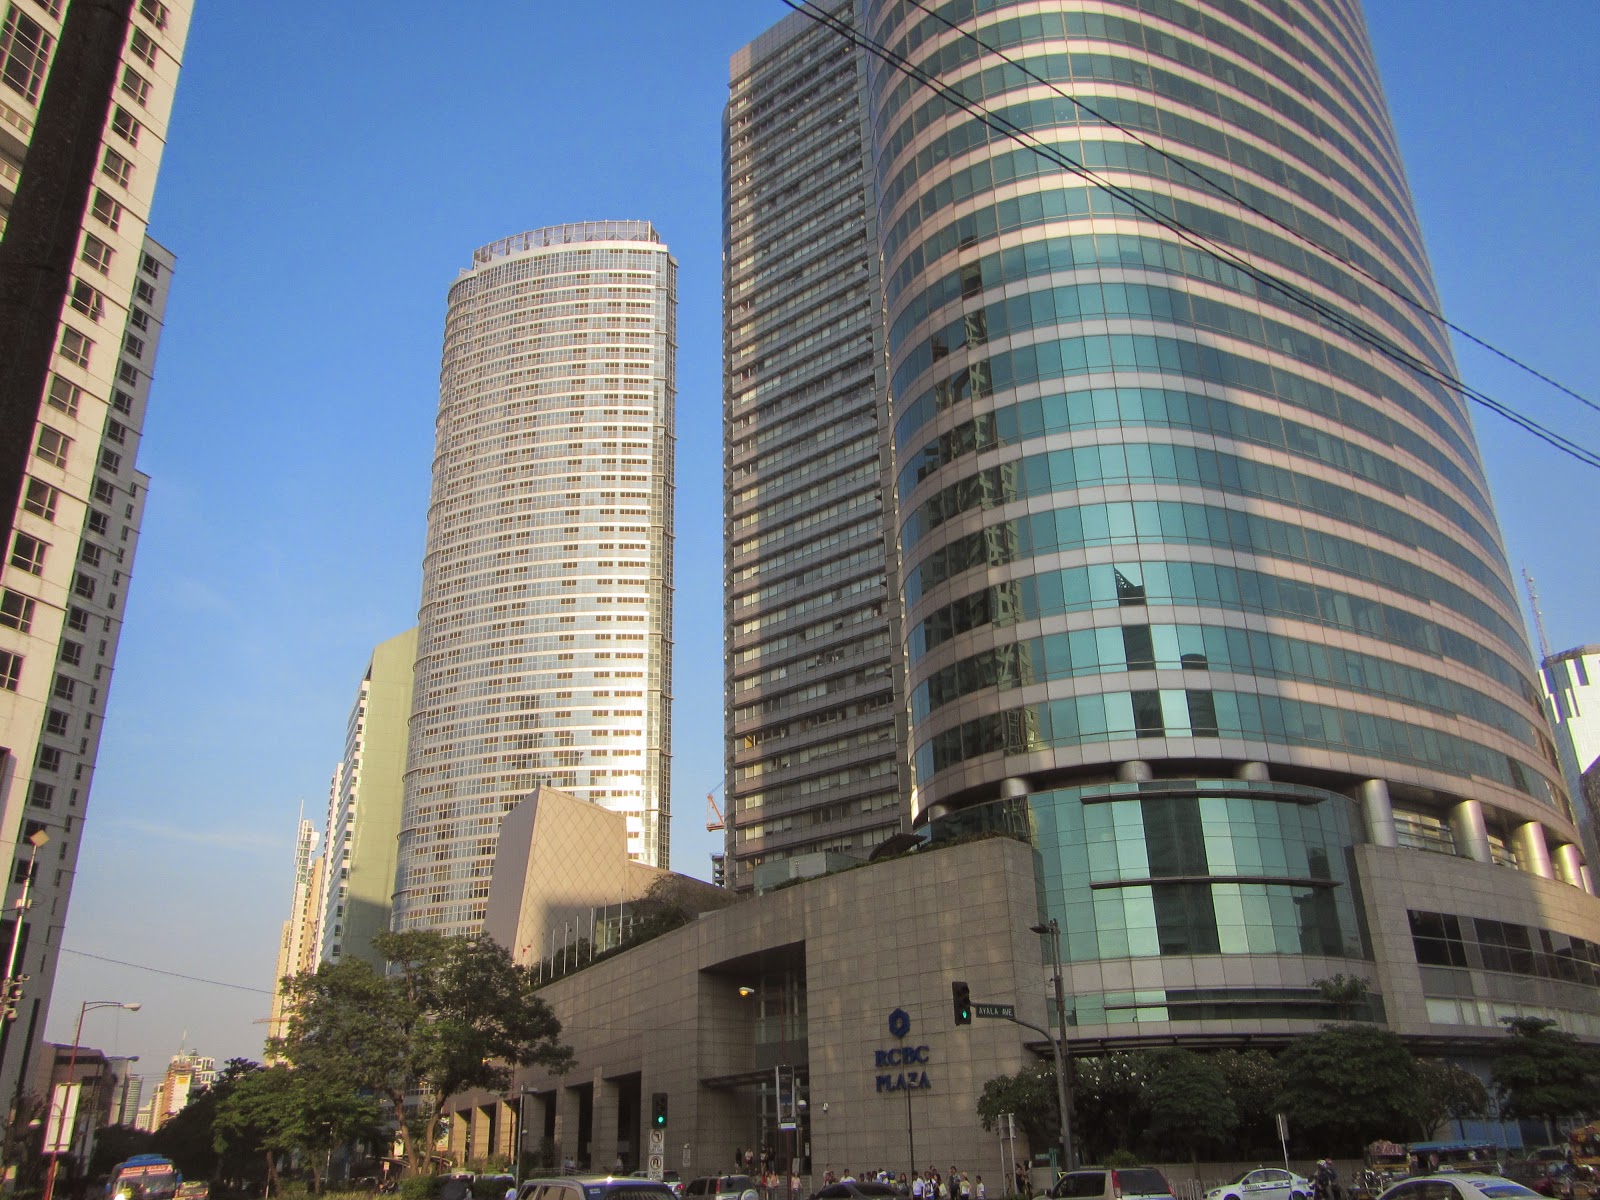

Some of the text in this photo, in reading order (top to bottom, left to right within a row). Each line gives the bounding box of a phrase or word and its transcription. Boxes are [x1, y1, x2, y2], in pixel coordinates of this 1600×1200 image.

[978, 1006, 999, 1016] AYALA
[874, 1046, 929, 1067] RCBC
[875, 1071, 931, 1092] PLAZA
